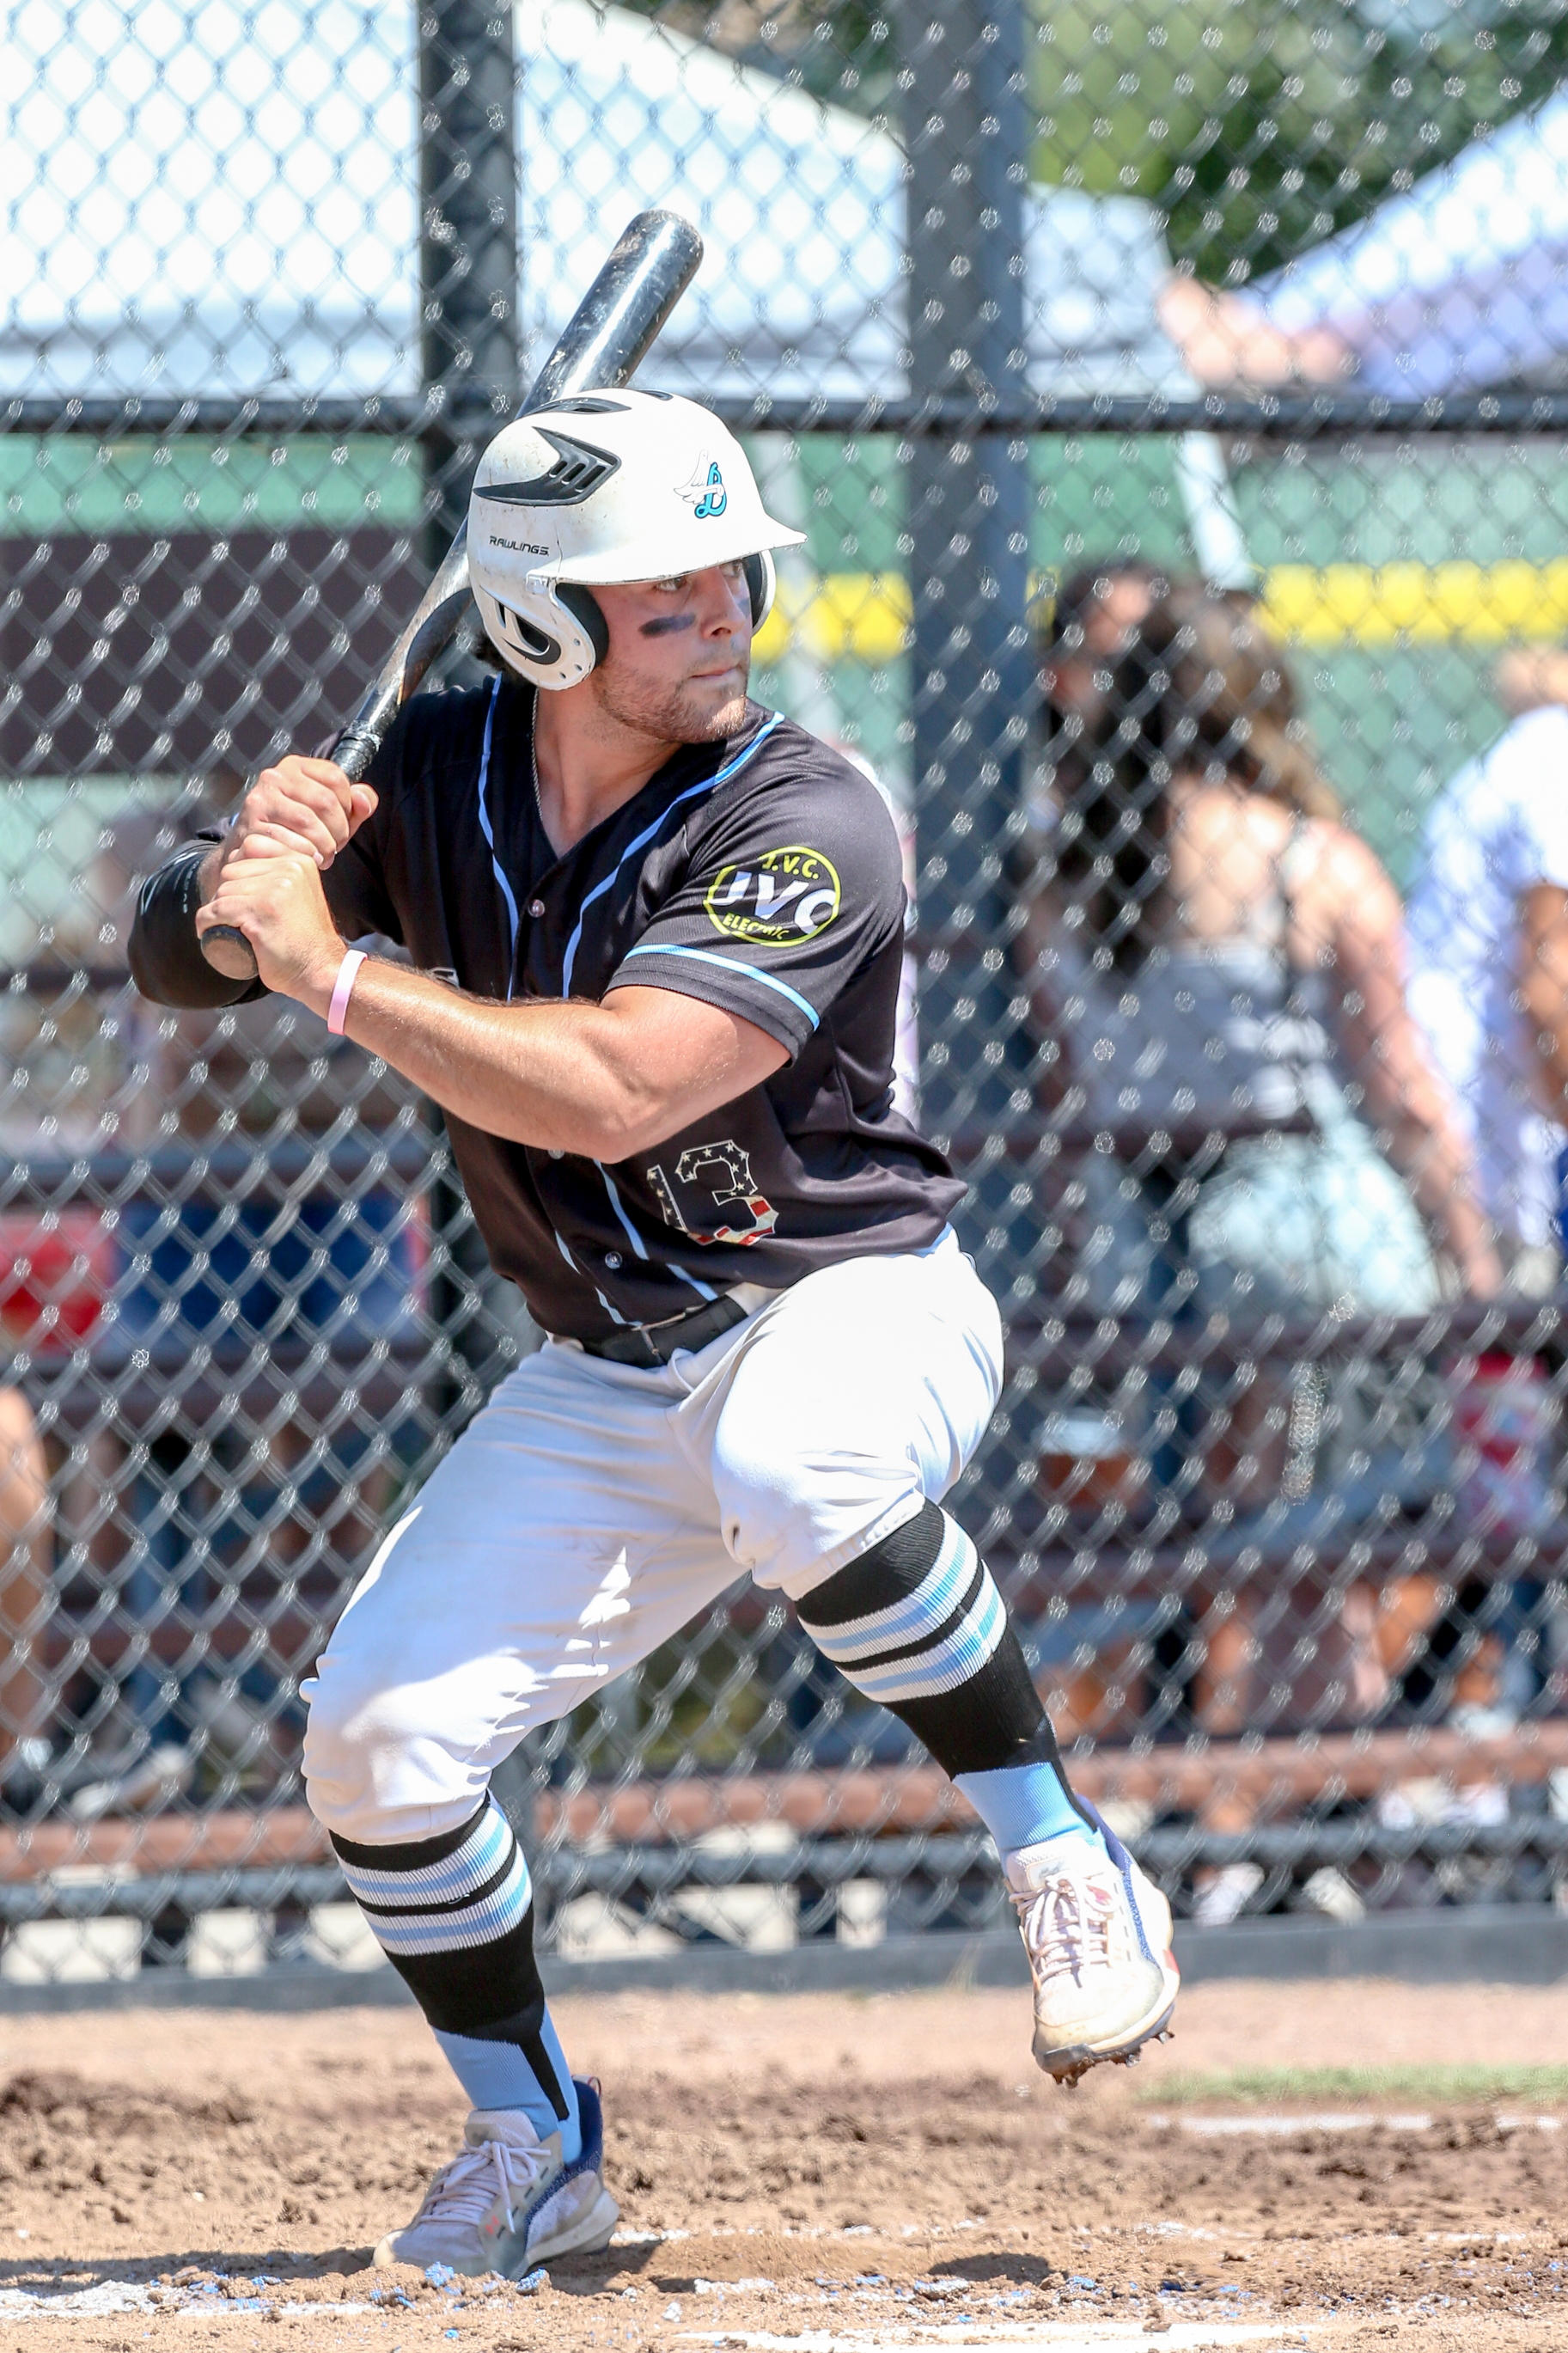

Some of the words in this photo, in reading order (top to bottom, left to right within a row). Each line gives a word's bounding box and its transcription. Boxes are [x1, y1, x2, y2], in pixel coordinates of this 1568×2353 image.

[489, 535, 549, 556] RAWLINGS
[709, 871, 837, 935] JVC
[646, 1139, 779, 1246] 13
